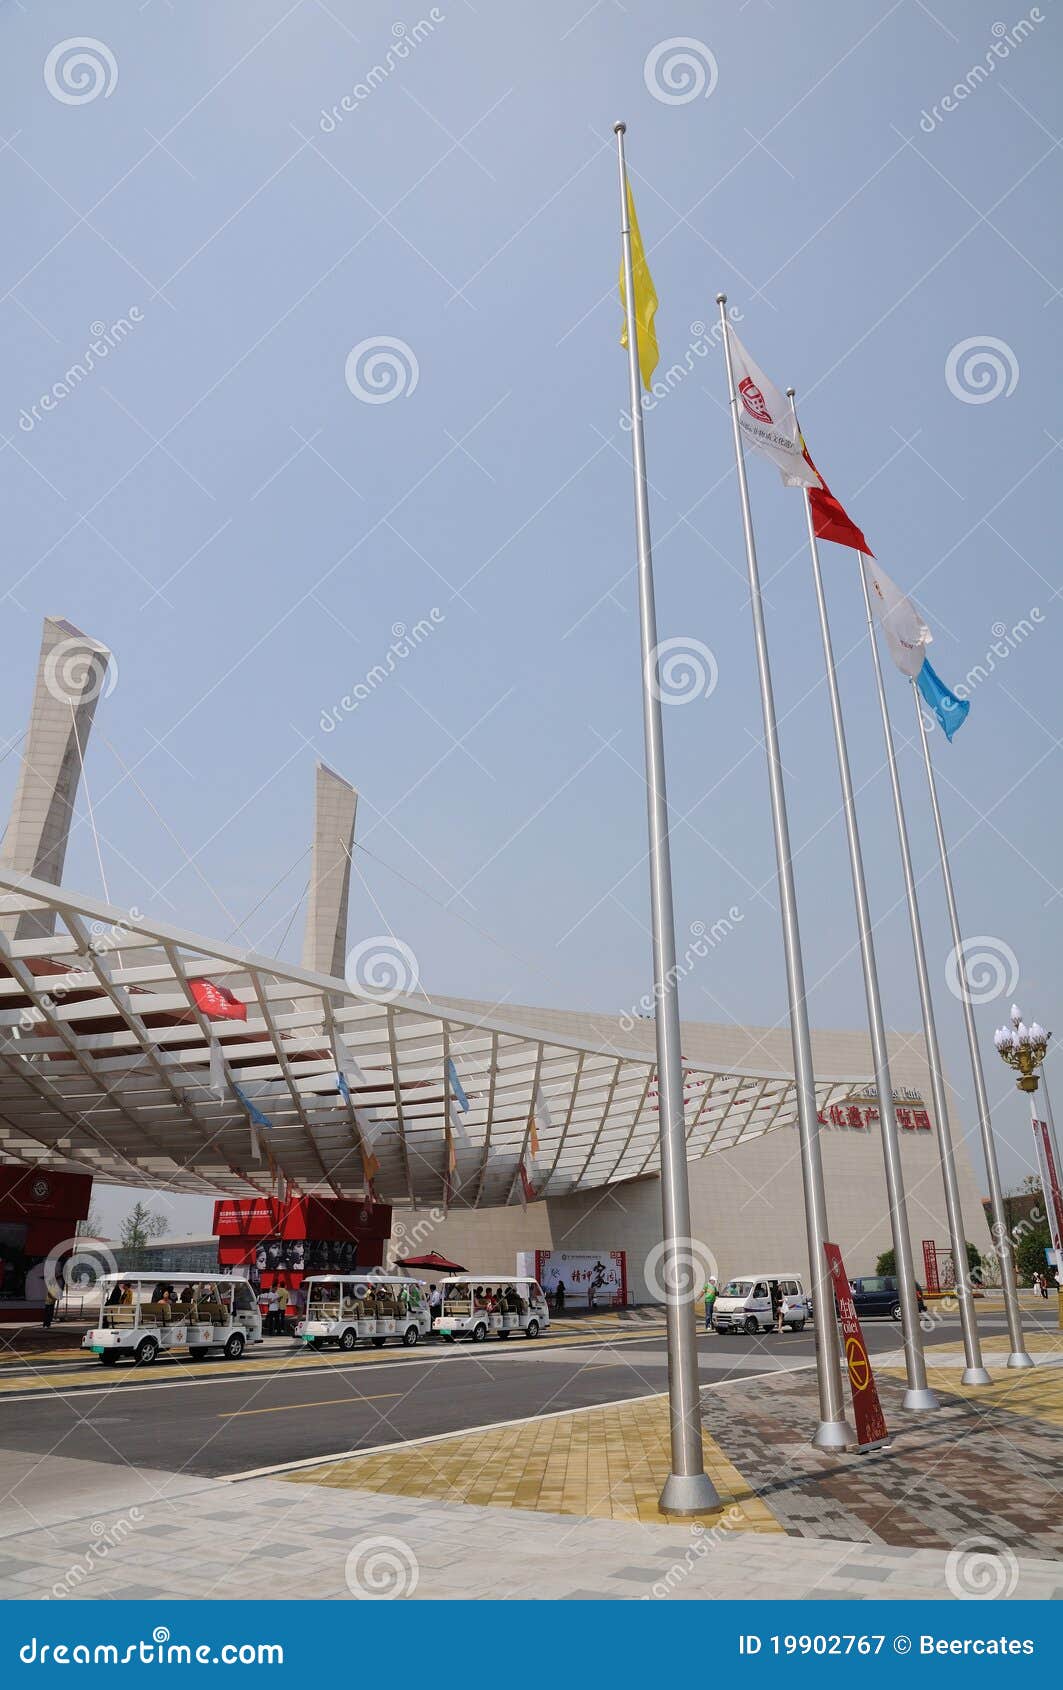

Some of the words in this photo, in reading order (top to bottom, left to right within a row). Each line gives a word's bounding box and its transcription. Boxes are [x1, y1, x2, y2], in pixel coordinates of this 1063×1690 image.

[816, 1105, 931, 1130] 文化遗产览园
